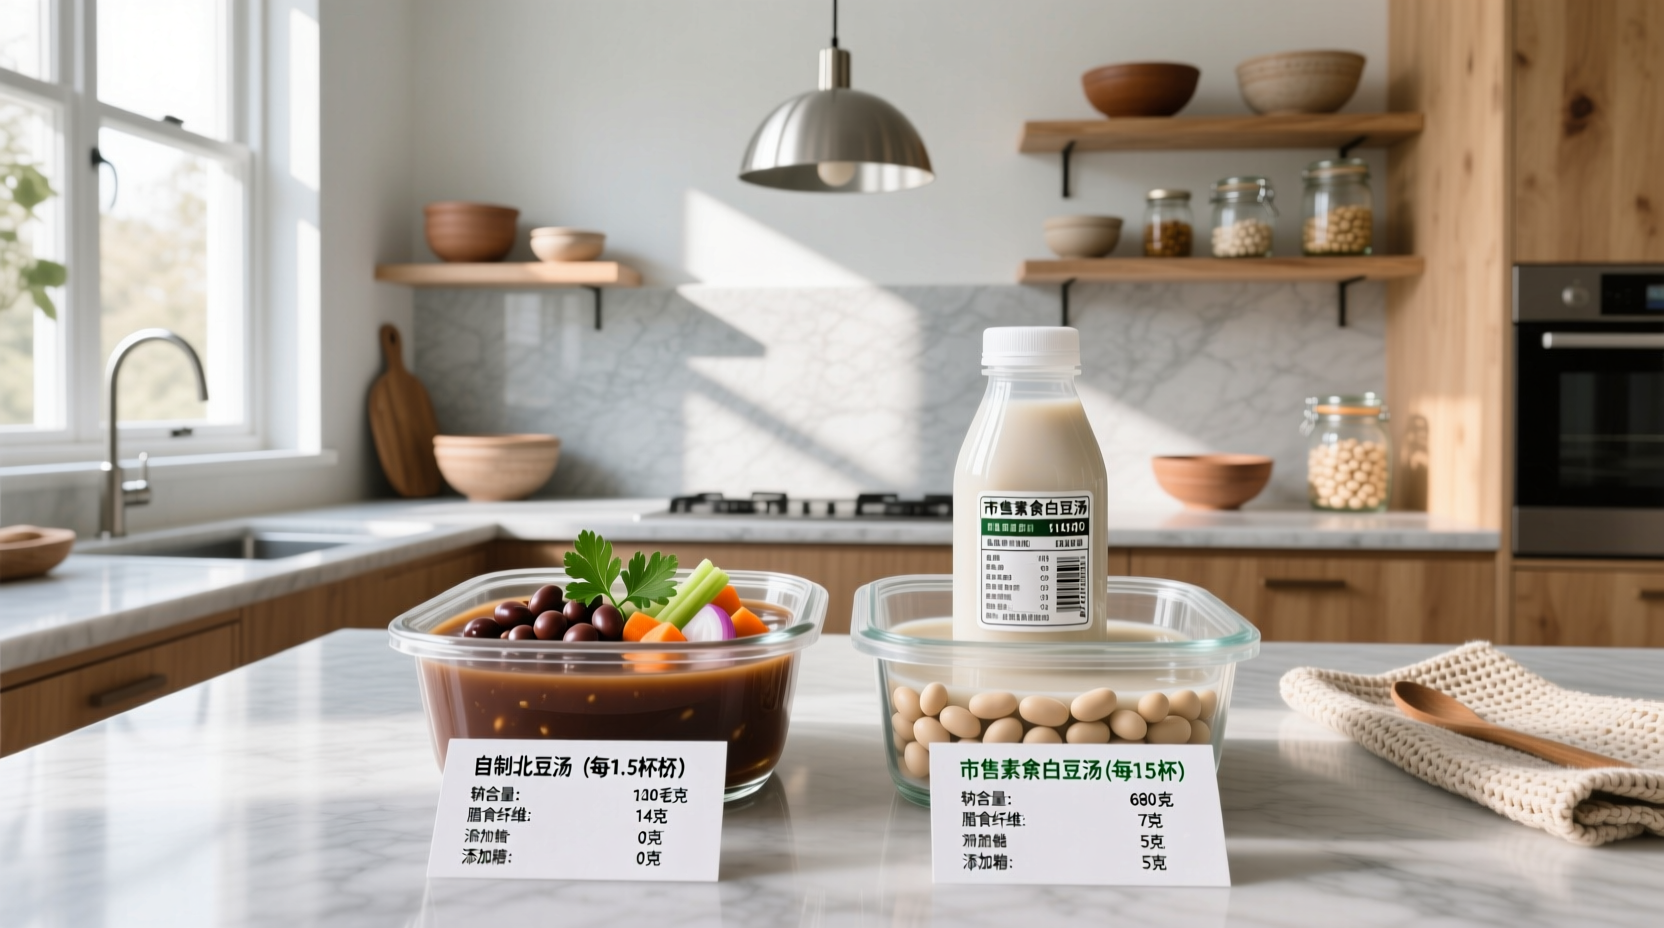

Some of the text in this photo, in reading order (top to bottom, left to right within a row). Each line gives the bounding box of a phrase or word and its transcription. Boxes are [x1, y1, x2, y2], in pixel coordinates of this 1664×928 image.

[475, 755, 572, 777] 自制北豆汤
[1130, 791, 1174, 807] 680克
[636, 808, 668, 824] 14克
[1138, 812, 1163, 828] 7克
[638, 830, 663, 845] 0克
[1141, 834, 1165, 849] 5克
[637, 850, 662, 866] 0克
[1142, 855, 1167, 870] 5克
